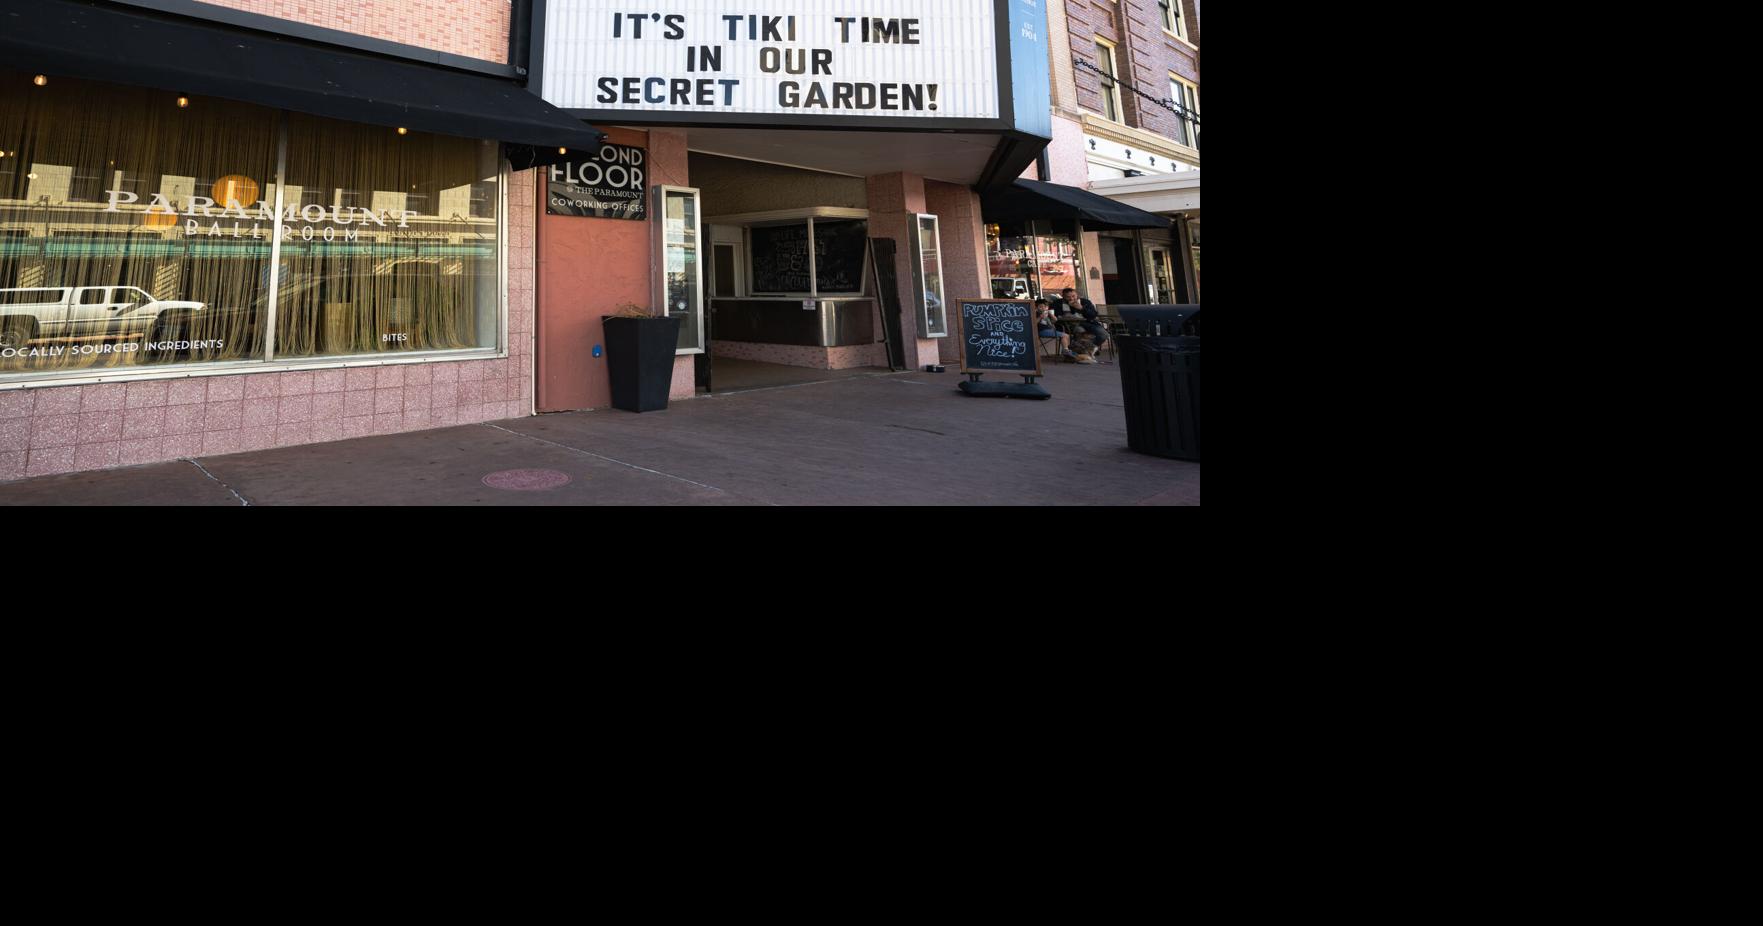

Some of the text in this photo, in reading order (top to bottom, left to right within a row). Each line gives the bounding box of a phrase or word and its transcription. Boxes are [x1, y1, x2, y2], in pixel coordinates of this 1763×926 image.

[613, 12, 920, 45] IT'S TIKI TIME
[687, 45, 833, 75] IN OUR
[597, 76, 938, 111] SECRET GARDEN!
[592, 145, 643, 165] OND
[551, 162, 643, 190] FLOOR
[575, 186, 593, 196] THE
[594, 187, 644, 199] PARAMOUNT
[102, 190, 417, 228] PARAMOUNT
[551, 197, 644, 212] COWORKING OFFICES
[382, 333, 407, 342] BITES
[968, 333, 1026, 354] Everything
[0, 339, 224, 358] OCALLY SOURCED INGREDIENTS
[976, 344, 1016, 358] Nice!
